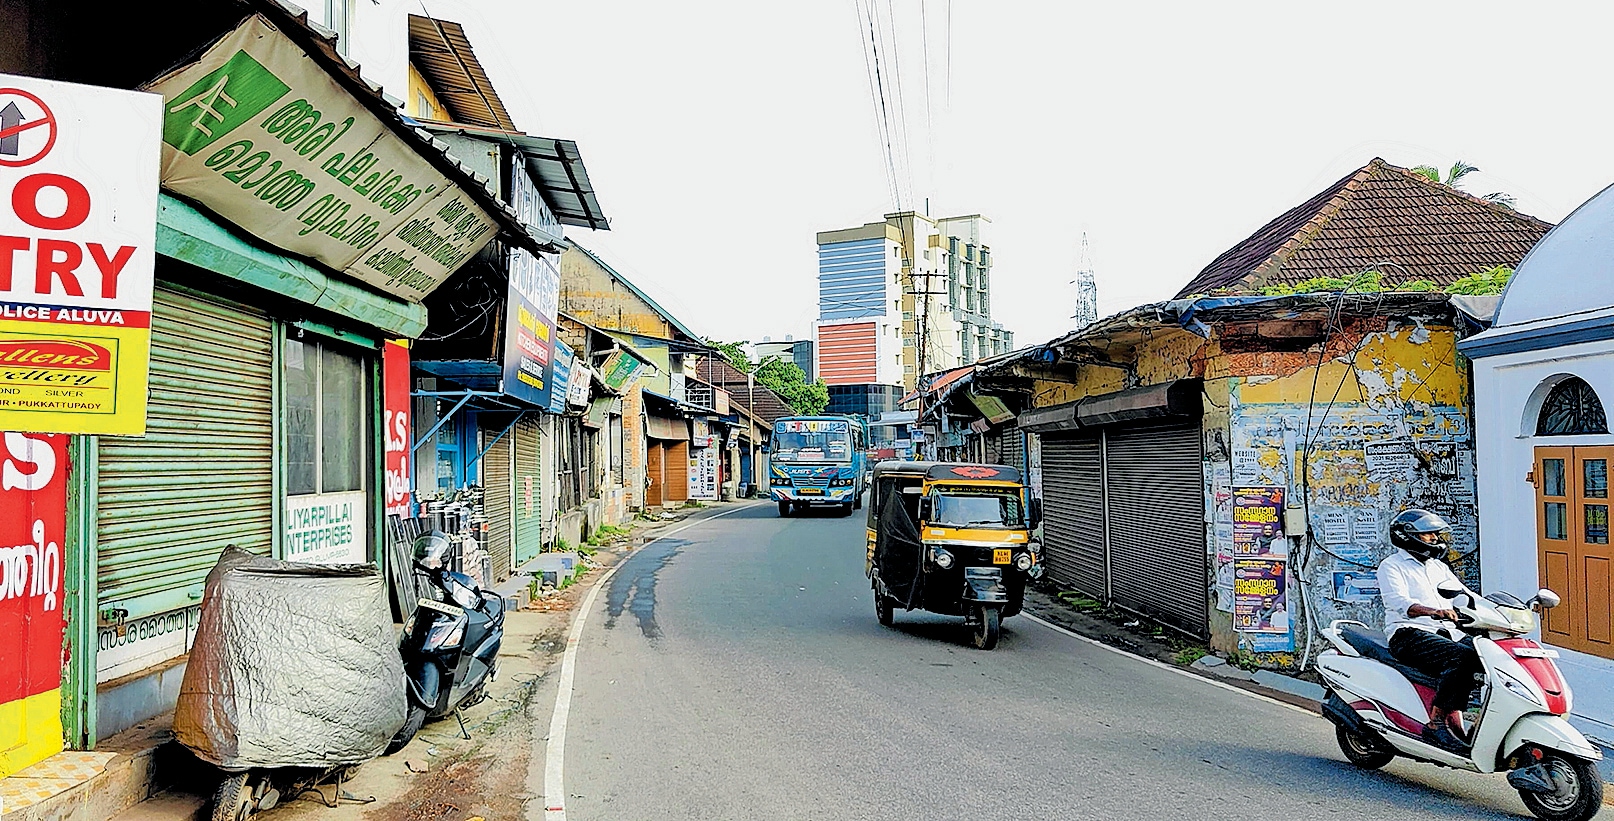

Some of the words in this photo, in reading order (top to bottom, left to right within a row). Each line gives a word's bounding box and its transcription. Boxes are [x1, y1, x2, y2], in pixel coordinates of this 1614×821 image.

[259, 97, 357, 156] അരി
[203, 138, 315, 211] മൊത്ത
[296, 192, 382, 250] വ്യാപാരം
[0, 304, 51, 320] LICE
[56, 308, 125, 325] ALUVA
[0, 370, 98, 386] ellery
[18, 400, 102, 410] PUKKATTUPADY
[45, 389, 84, 397] SILVER
[286, 524, 353, 555] NTERPRISES
[139, 610, 185, 642] മൊത്ത
